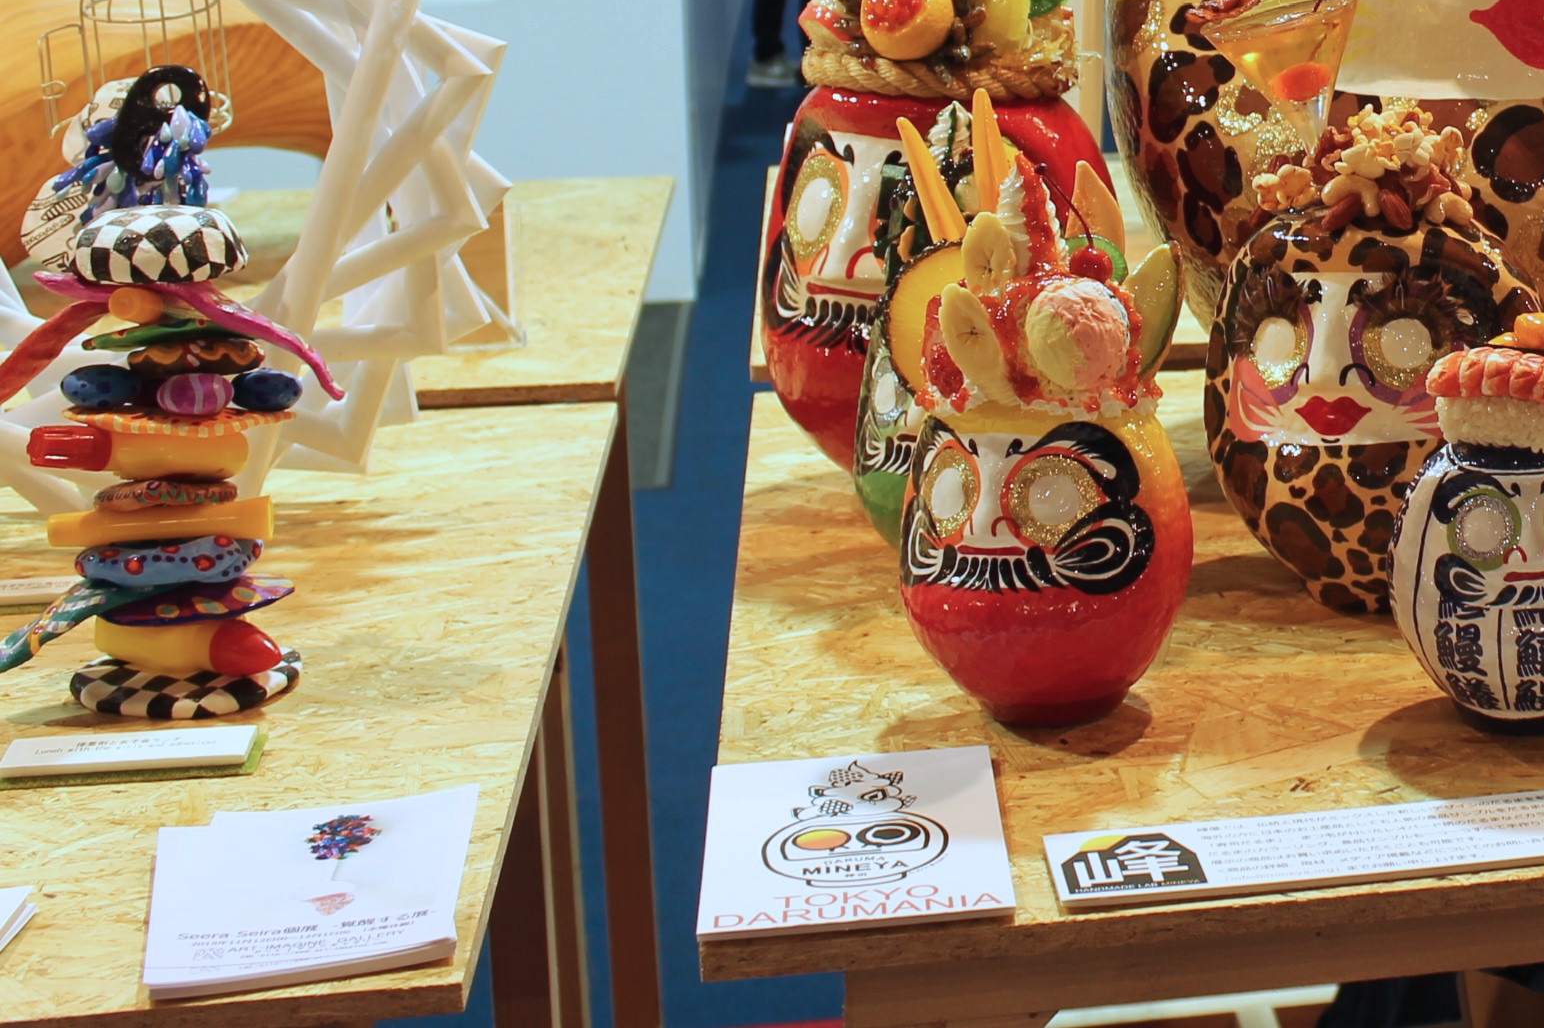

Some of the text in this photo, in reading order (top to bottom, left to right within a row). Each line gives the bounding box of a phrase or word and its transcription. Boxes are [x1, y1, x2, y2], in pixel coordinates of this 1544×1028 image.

[1072, 839, 1190, 889] 峰
[774, 883, 940, 910] TOKYO
[1138, 881, 1159, 889] LAB
[712, 891, 1004, 930] DARUMANIA
